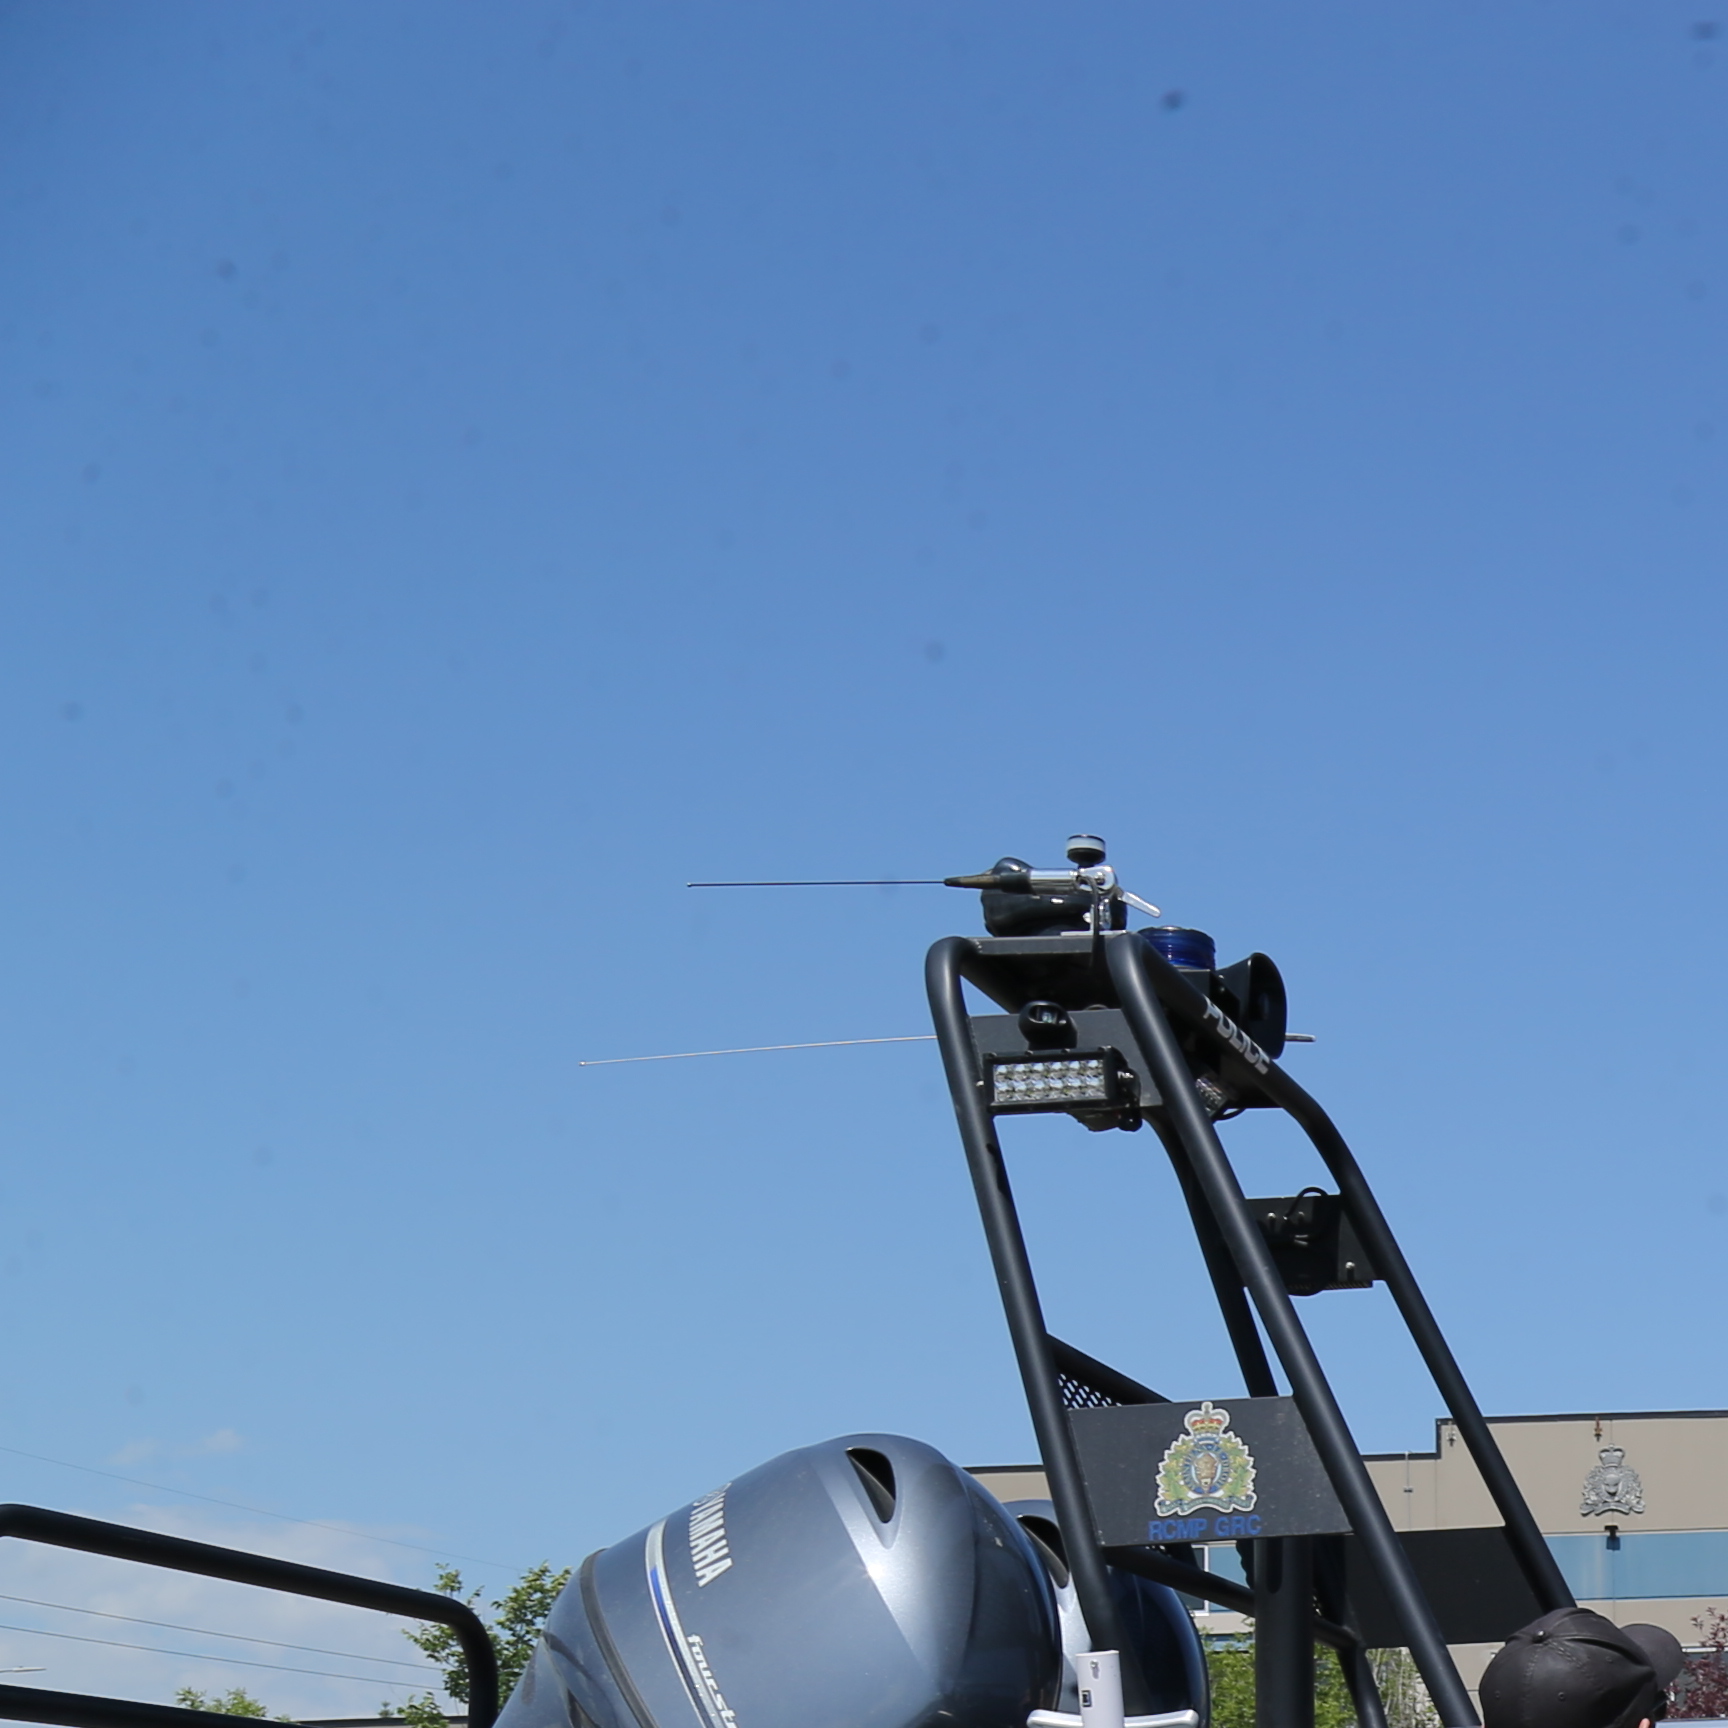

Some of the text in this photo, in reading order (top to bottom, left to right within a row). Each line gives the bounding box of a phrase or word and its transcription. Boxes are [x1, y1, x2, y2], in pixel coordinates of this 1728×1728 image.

[688, 1490, 735, 1588] YAMAHA
[1148, 1514, 1262, 1541] RCMP GRC
